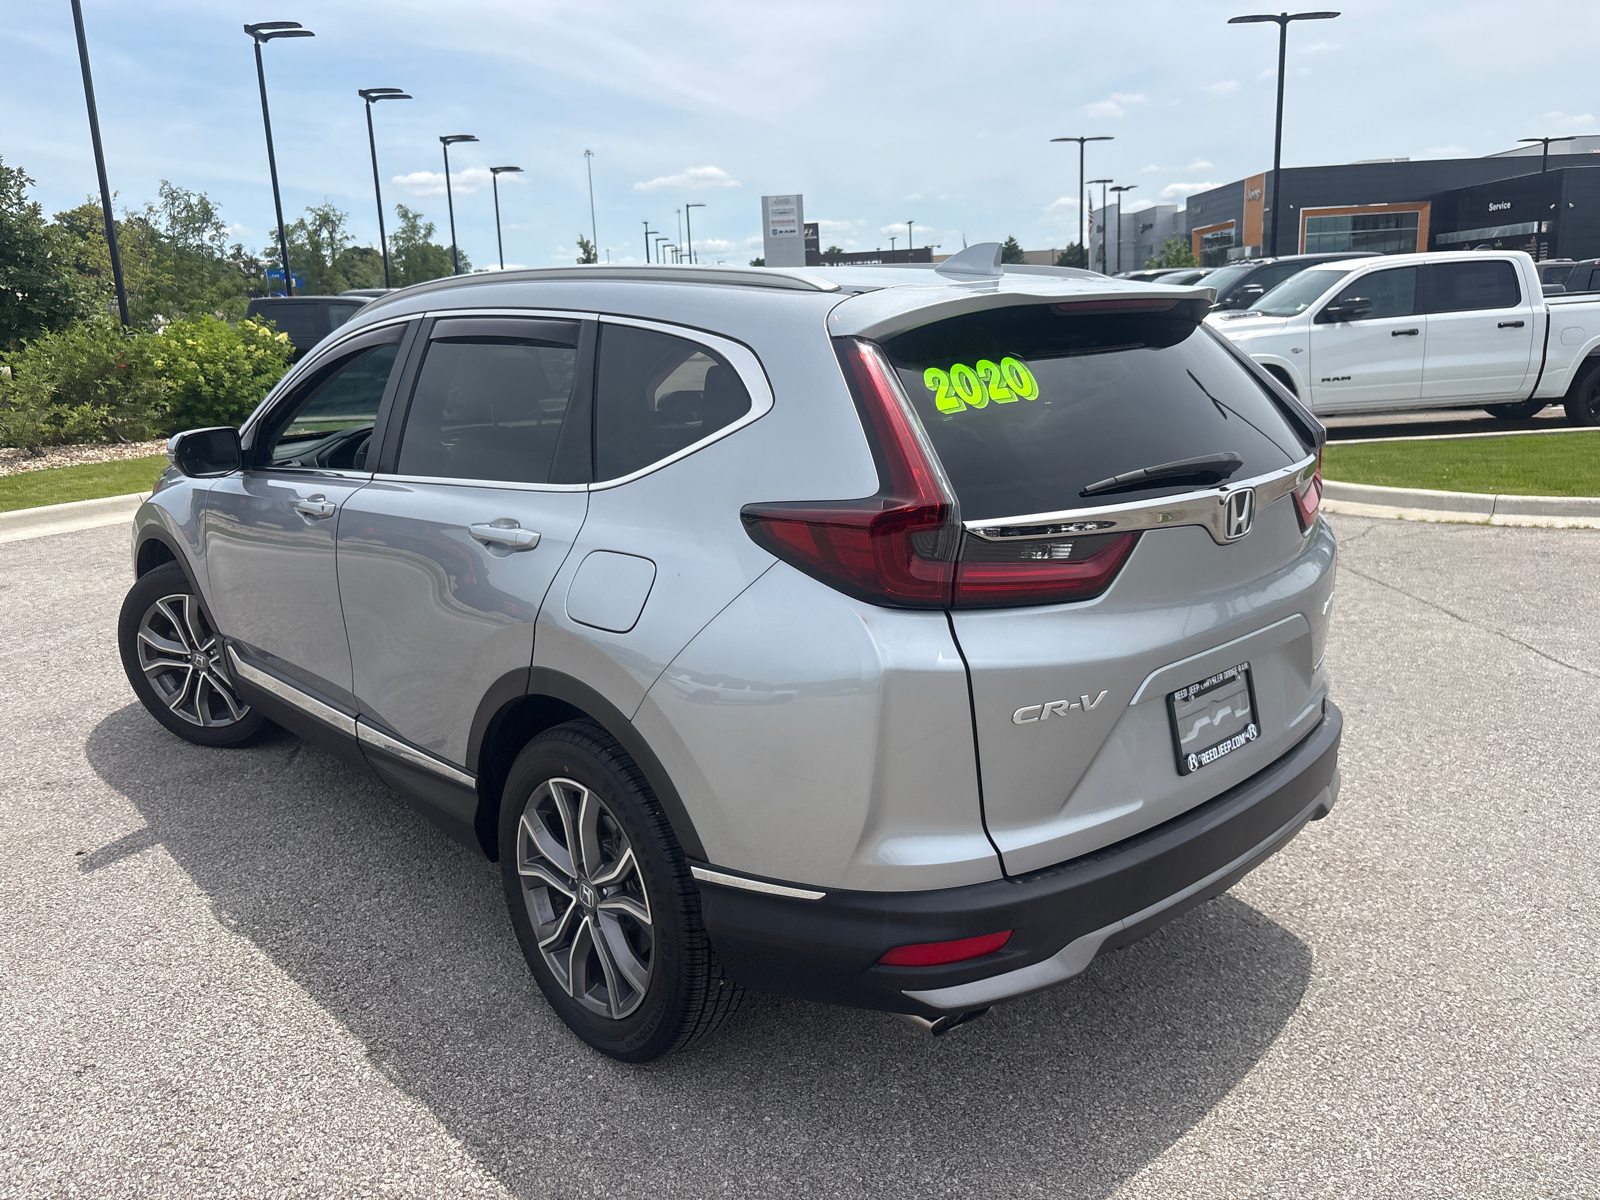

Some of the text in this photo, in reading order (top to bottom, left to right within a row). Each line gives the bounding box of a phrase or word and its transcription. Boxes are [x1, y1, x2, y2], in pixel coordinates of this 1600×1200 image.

[1488, 201, 1511, 212] Service
[923, 356, 1039, 415] 2020
[1174, 688, 1188, 701] REED
[1188, 683, 1200, 696] JEEP
[1223, 666, 1238, 680] DODGE
[1012, 689, 1108, 725] CR-V
[1201, 731, 1247, 766] REEDJEEP.COM
